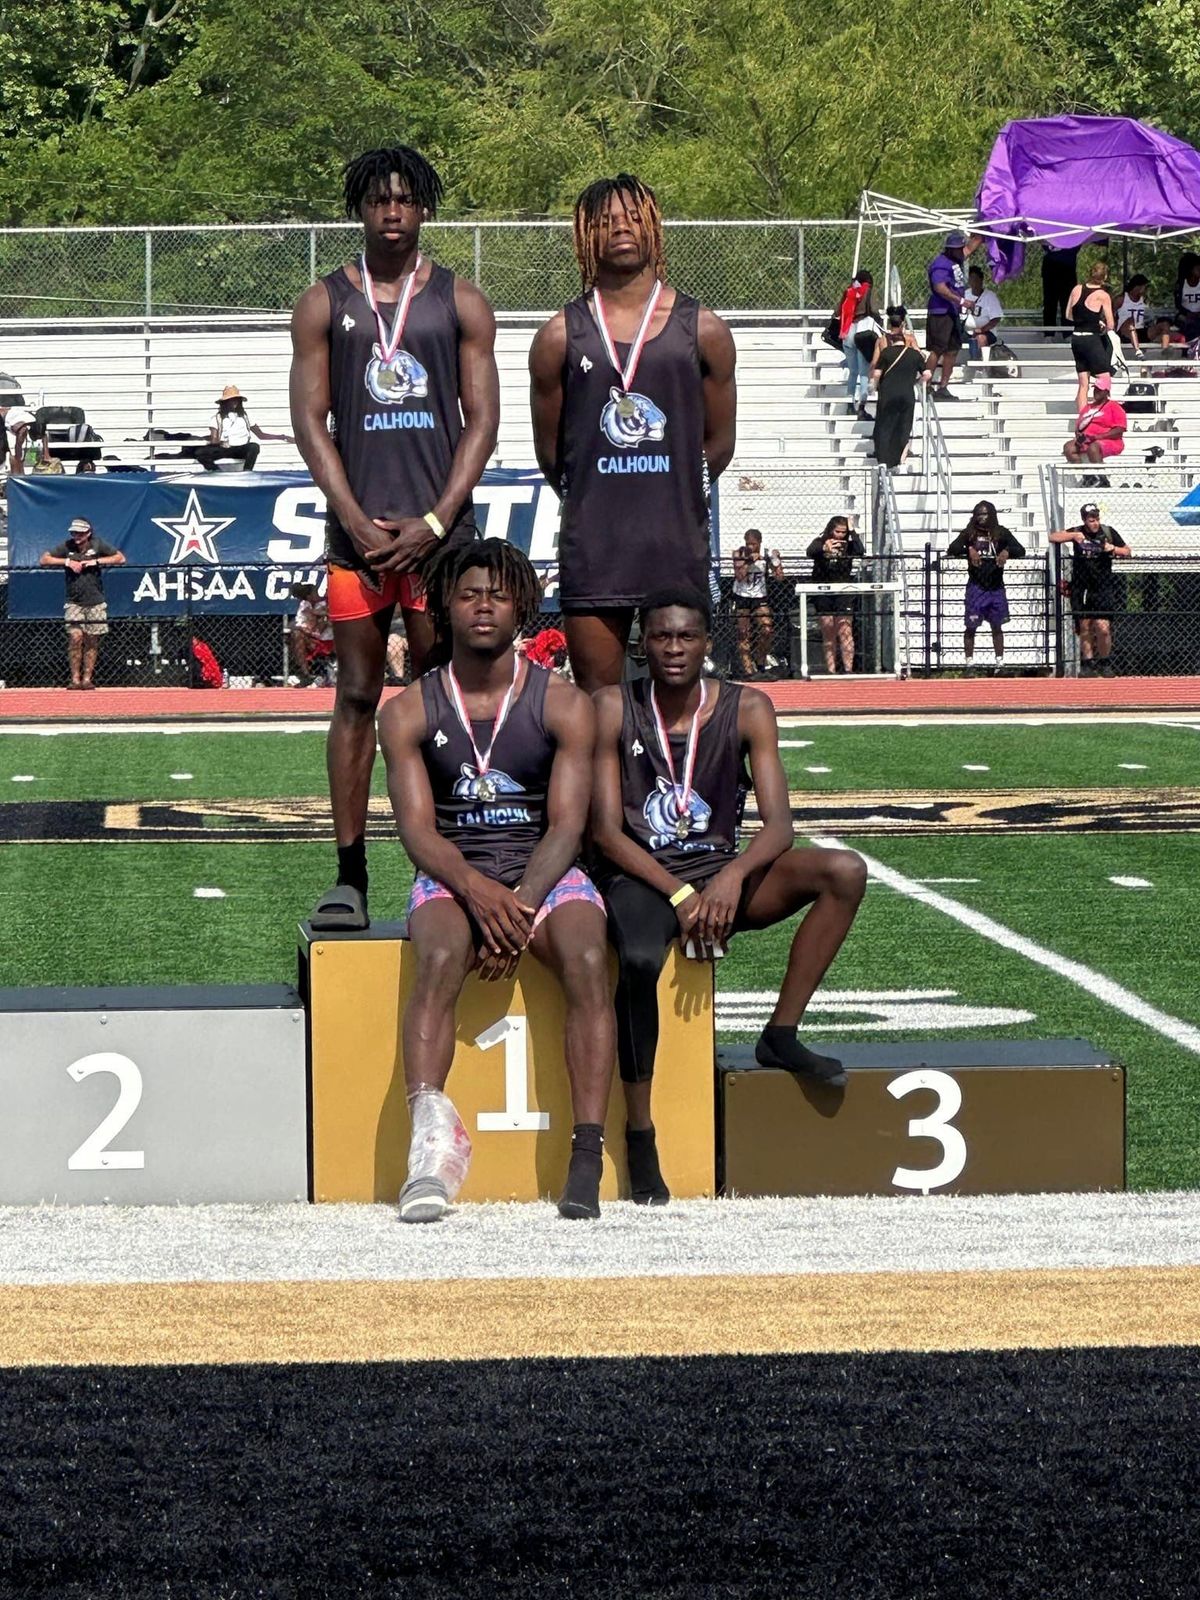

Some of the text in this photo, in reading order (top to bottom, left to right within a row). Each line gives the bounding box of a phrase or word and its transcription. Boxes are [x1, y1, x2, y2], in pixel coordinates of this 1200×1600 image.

[364, 411, 435, 431] CALHOUN
[597, 455, 670, 474] CALHOUN
[133, 570, 256, 602] AHSAA
[474, 1015, 550, 1131] 1
[66, 1052, 145, 1170] 2
[886, 1069, 967, 1190] 3
